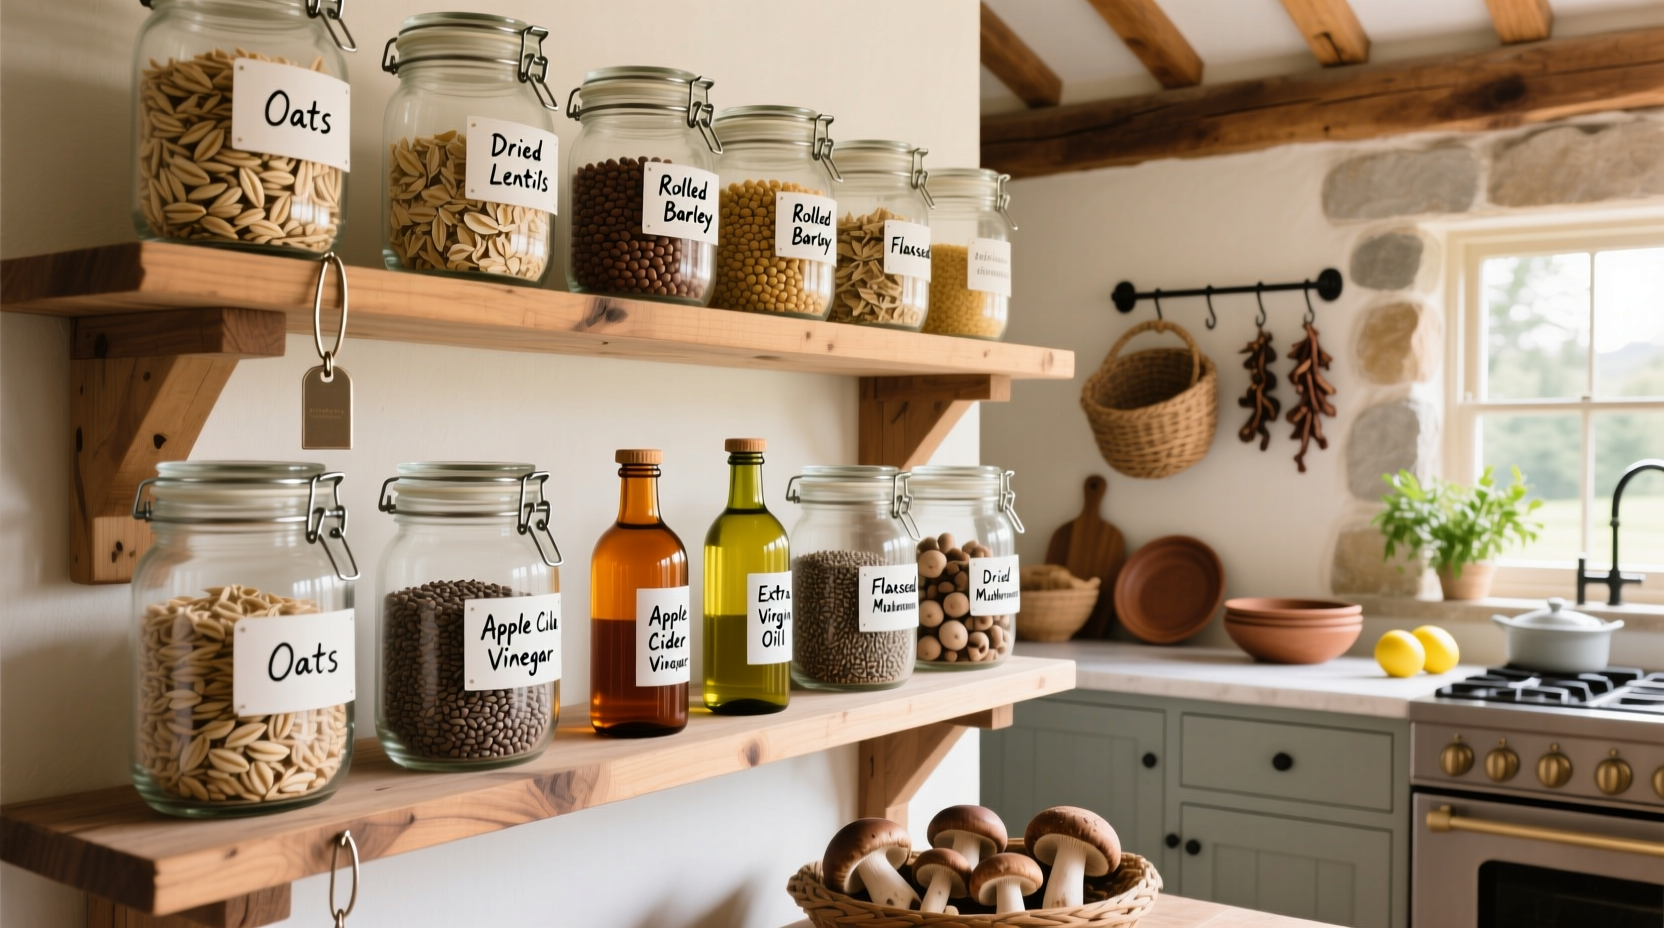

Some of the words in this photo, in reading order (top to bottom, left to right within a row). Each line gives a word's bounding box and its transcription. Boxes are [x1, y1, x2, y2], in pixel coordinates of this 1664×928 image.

[265, 90, 332, 135] Oats
[491, 133, 543, 162] Dried
[490, 162, 549, 193] Lentils
[659, 174, 708, 201] Rolled
[663, 200, 713, 234] Barley
[792, 203, 832, 227] Rolled
[758, 585, 791, 602] Extra
[480, 612, 532, 646] Apple
[649, 605, 687, 630] Apple
[758, 608, 791, 629] Virgin
[649, 631, 686, 651] Cider
[762, 630, 785, 648] Oill
[268, 642, 338, 682] Oats
[488, 647, 554, 677] Vinegar
